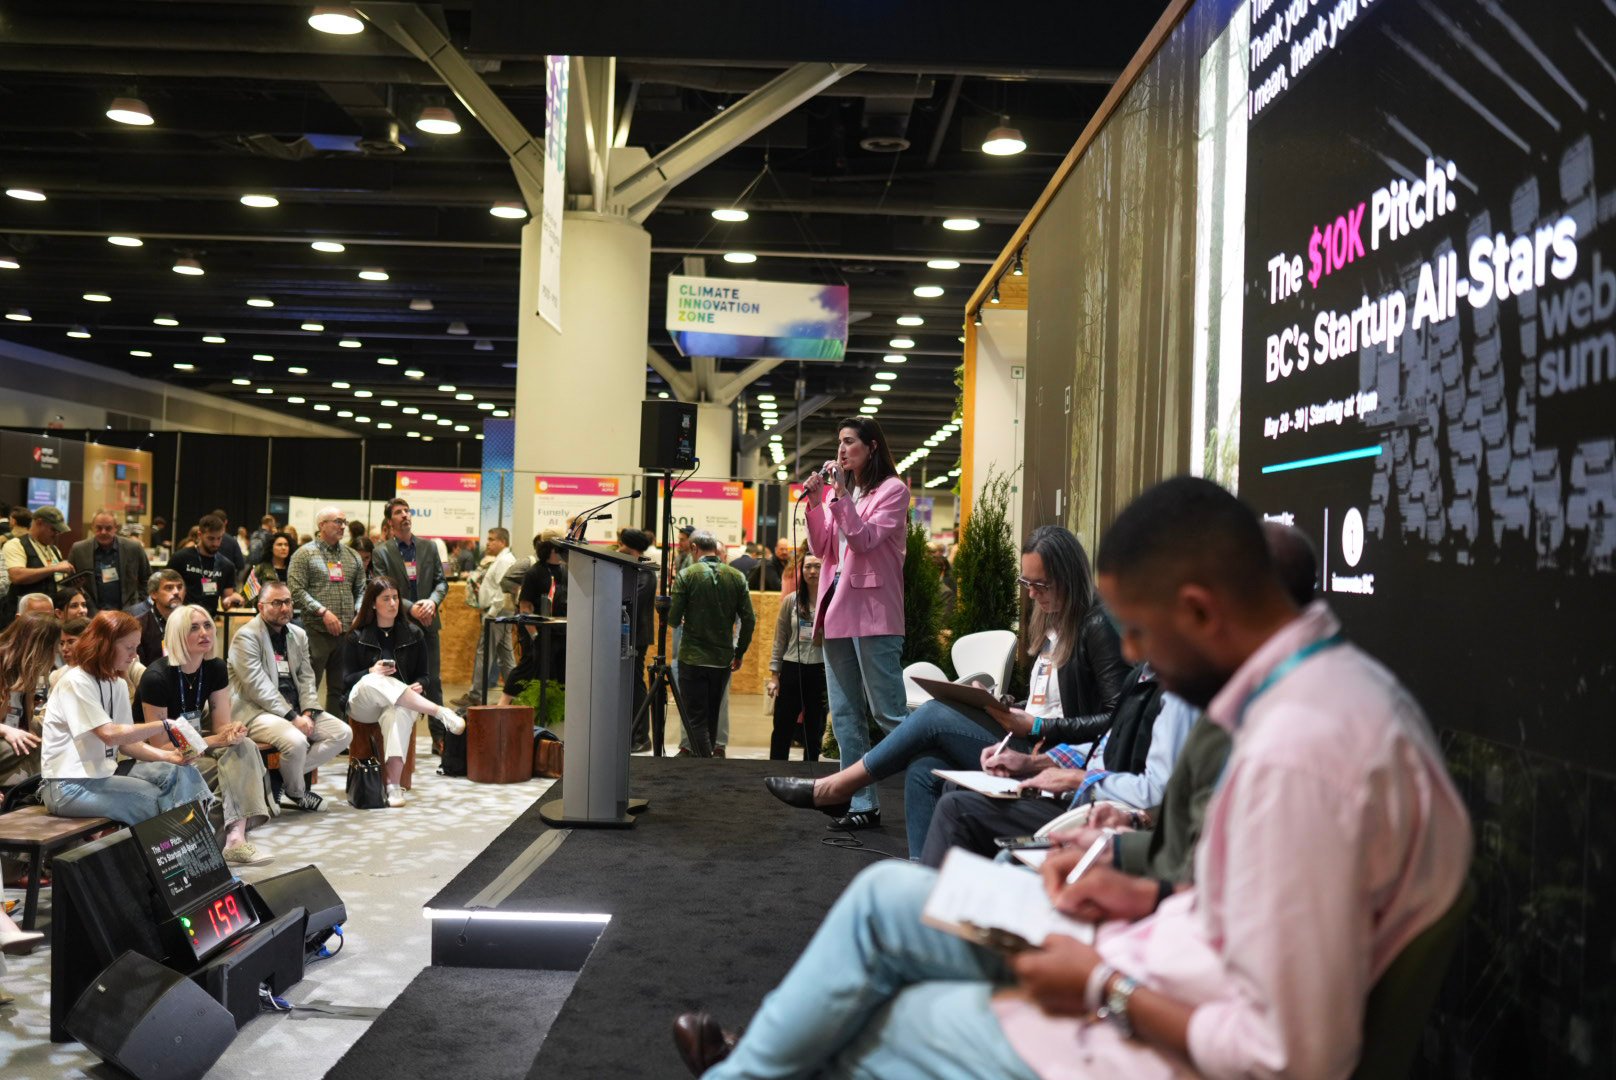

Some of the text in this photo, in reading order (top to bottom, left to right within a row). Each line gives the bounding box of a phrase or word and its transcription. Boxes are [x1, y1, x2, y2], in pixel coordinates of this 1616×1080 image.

[1249, 0, 1357, 120] I mean, thank you
[1250, 0, 1308, 71] Thank you
[1268, 157, 1456, 304] The $10K Pitch:
[678, 311, 715, 323] ZONE
[679, 298, 760, 314] INNOVATION
[680, 284, 739, 300] CLIMATE
[1266, 216, 1577, 382] BC's Startup All-Stars
[1540, 252, 1616, 340] web
